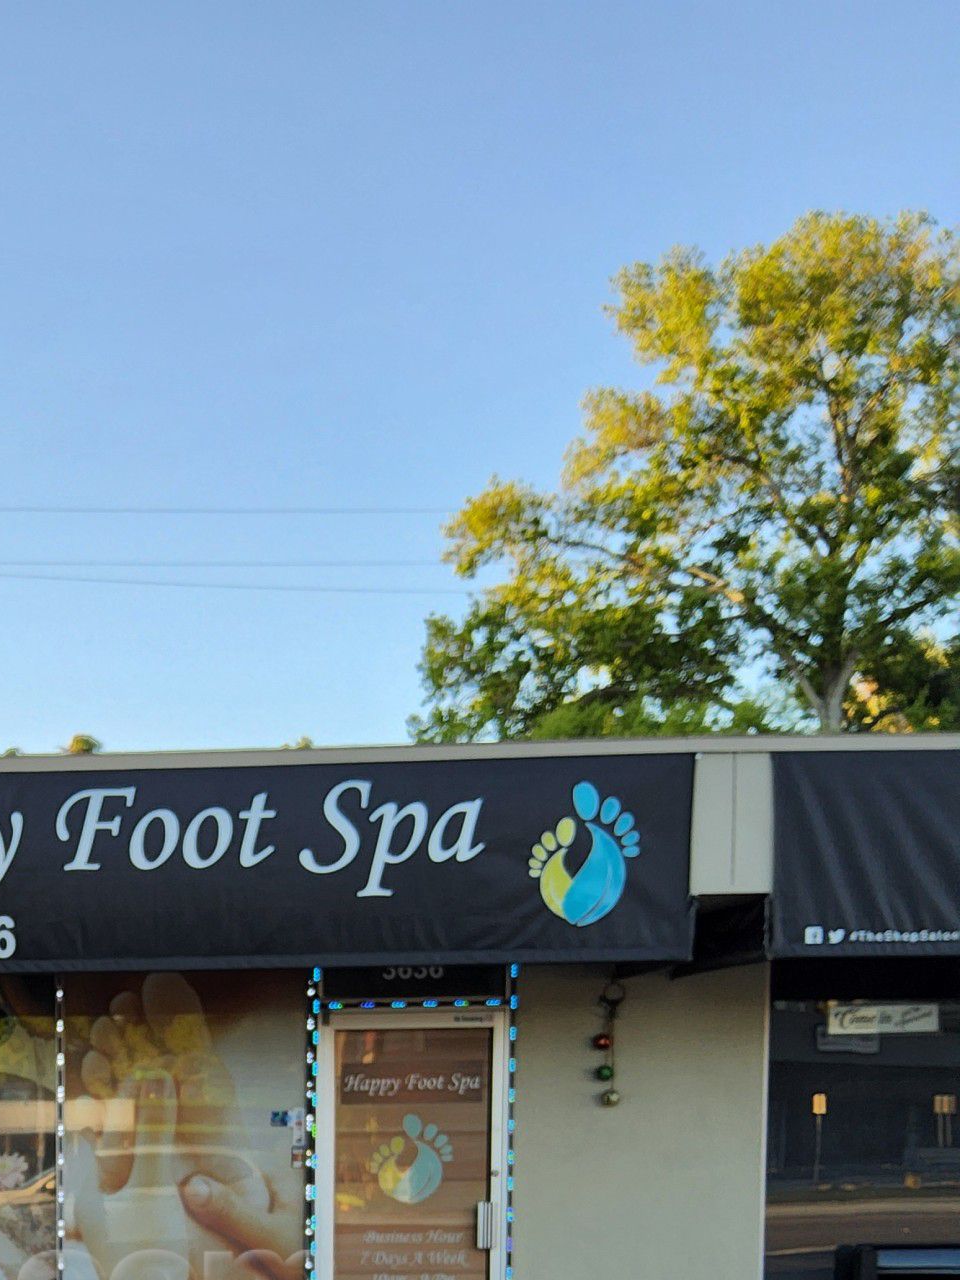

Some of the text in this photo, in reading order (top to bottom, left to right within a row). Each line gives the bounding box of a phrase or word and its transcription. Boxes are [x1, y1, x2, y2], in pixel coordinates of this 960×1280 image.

[55, 785, 276, 872] Foot
[298, 779, 485, 898] Spa
[344, 1072, 481, 1097] Happy Foot Spa
